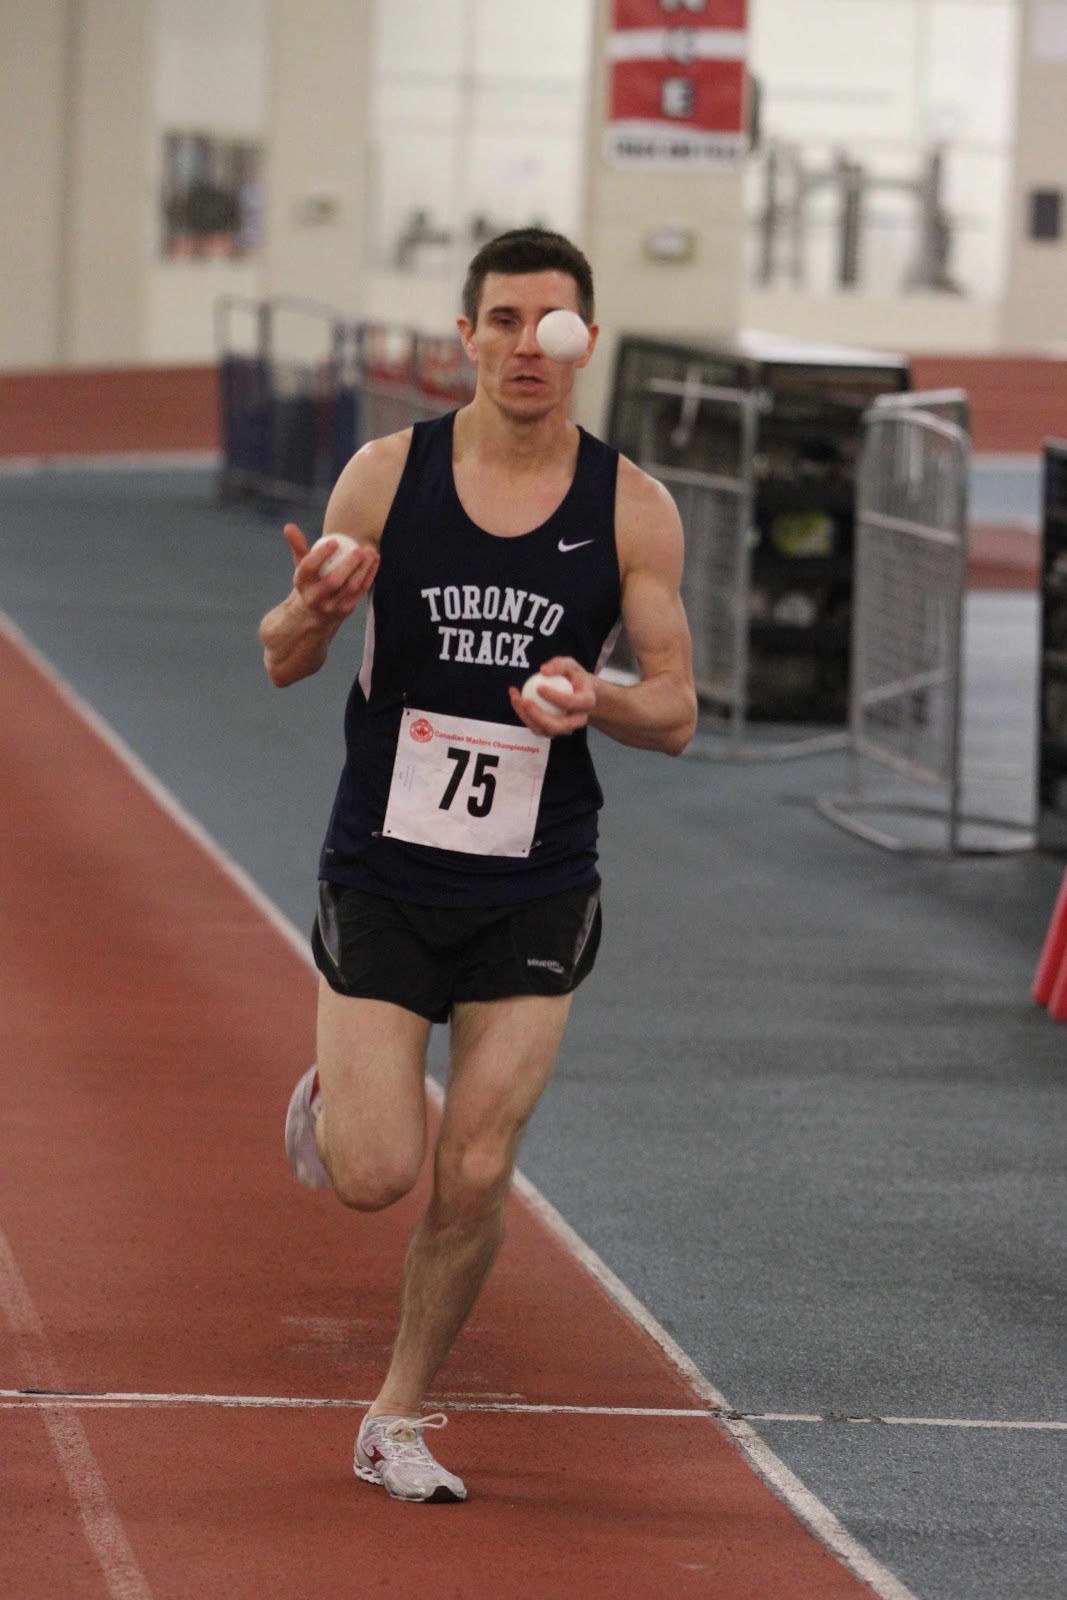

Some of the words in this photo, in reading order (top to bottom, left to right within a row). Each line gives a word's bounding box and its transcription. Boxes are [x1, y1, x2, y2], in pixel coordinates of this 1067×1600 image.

[421, 585, 565, 637] TORONTO
[438, 626, 534, 669] TRACK
[434, 730, 464, 742] Canadian
[465, 736, 492, 747] Masters
[492, 740, 540, 754] Championships
[438, 747, 500, 818] 75
